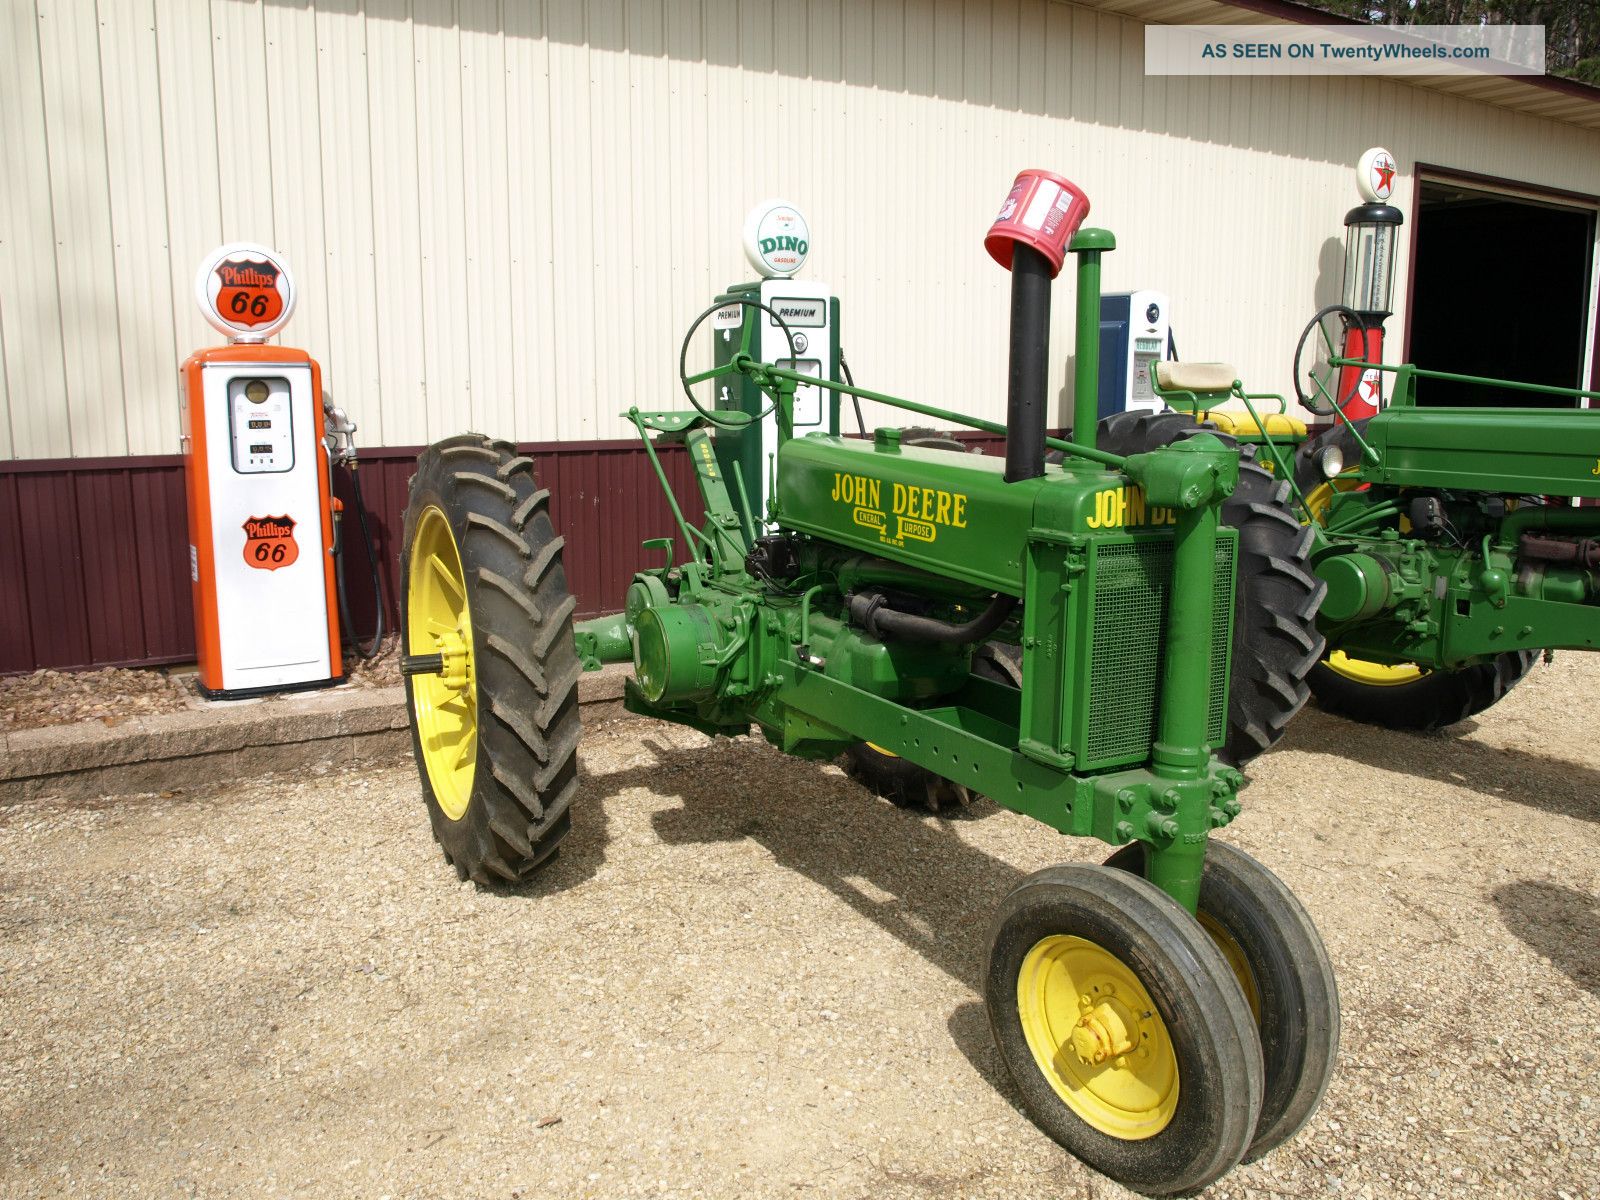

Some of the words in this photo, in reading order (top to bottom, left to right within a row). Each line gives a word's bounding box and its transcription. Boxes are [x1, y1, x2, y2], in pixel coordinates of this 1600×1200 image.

[760, 235, 808, 255] DINO
[221, 265, 274, 290] Phillips
[231, 291, 269, 317] 66
[779, 308, 815, 318] PREMIUM
[717, 310, 741, 320] PREMIUM
[831, 472, 881, 509] JOHN
[892, 482, 967, 529] DEERE
[1086, 485, 1146, 529] JOHN
[246, 522, 291, 540] Phillips
[255, 542, 288, 563] 66
